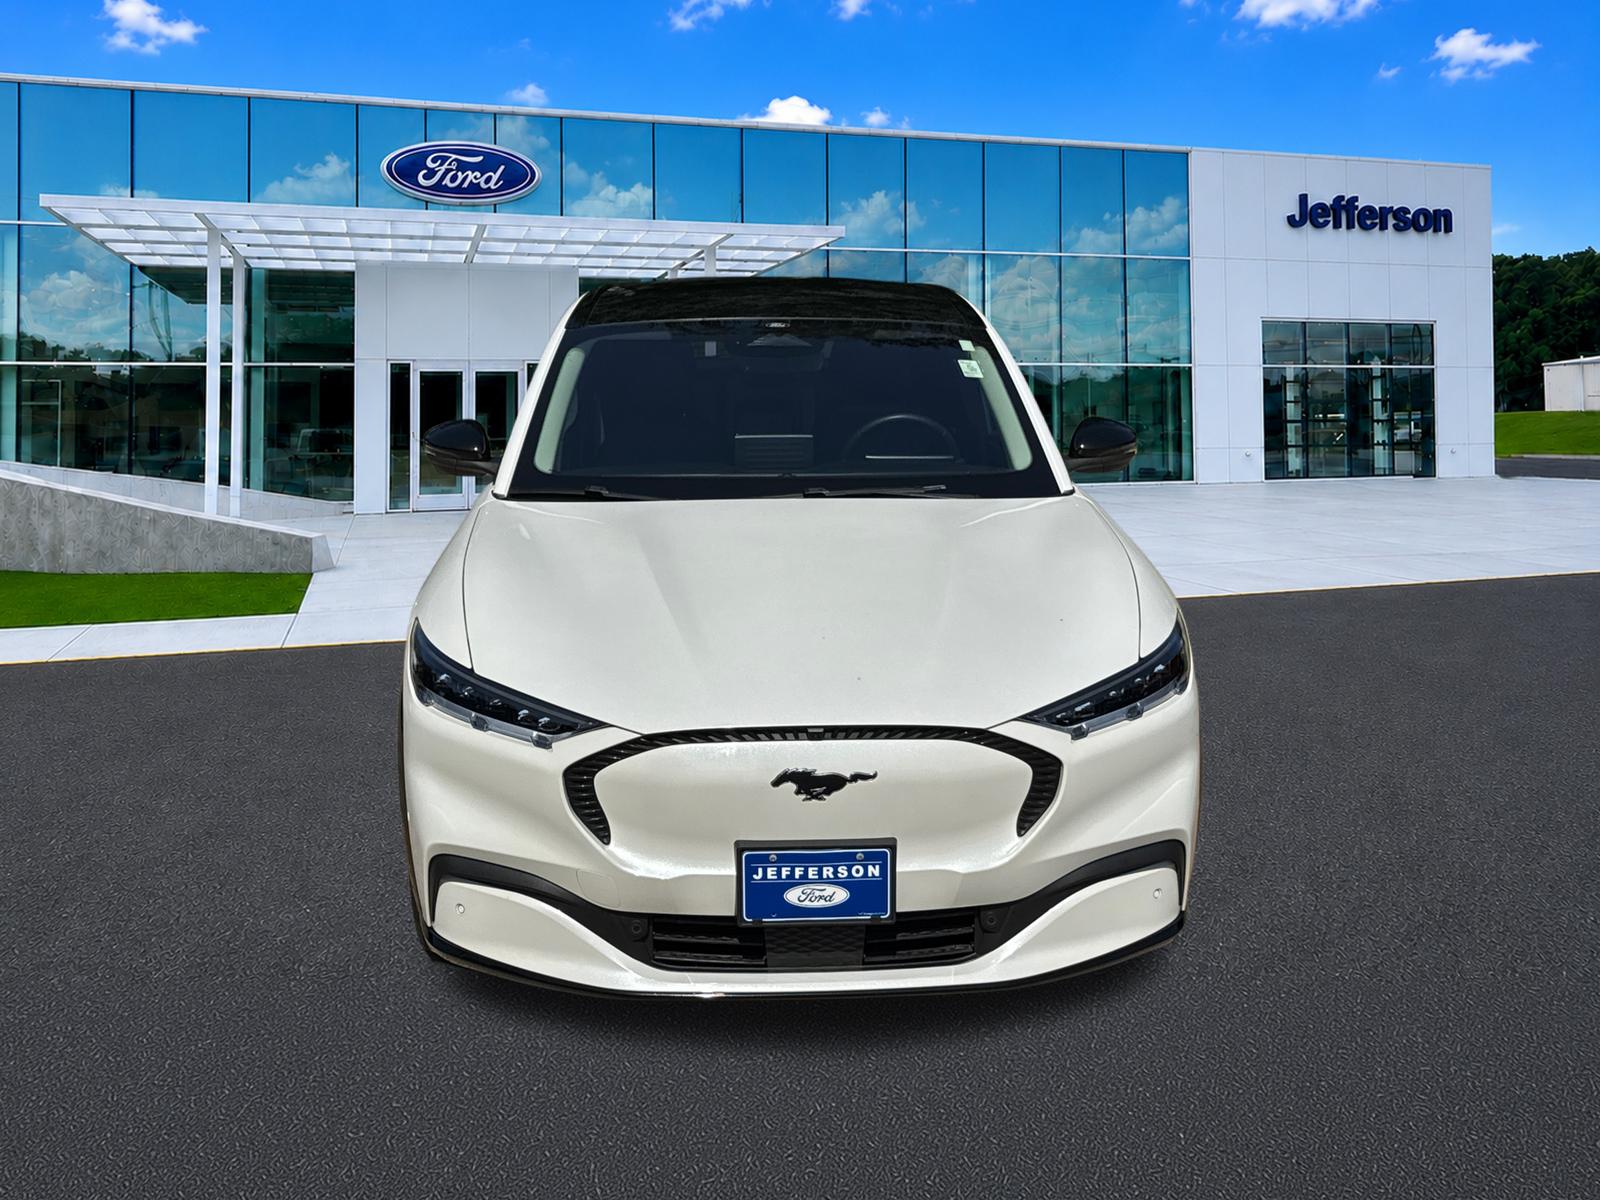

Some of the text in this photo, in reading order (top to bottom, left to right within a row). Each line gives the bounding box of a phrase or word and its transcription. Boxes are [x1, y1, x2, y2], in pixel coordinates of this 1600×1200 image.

[417, 152, 506, 189] Ford
[1286, 193, 1453, 233] Jefferson
[752, 864, 881, 880] JEFFERSON
[797, 887, 837, 903] Ford
